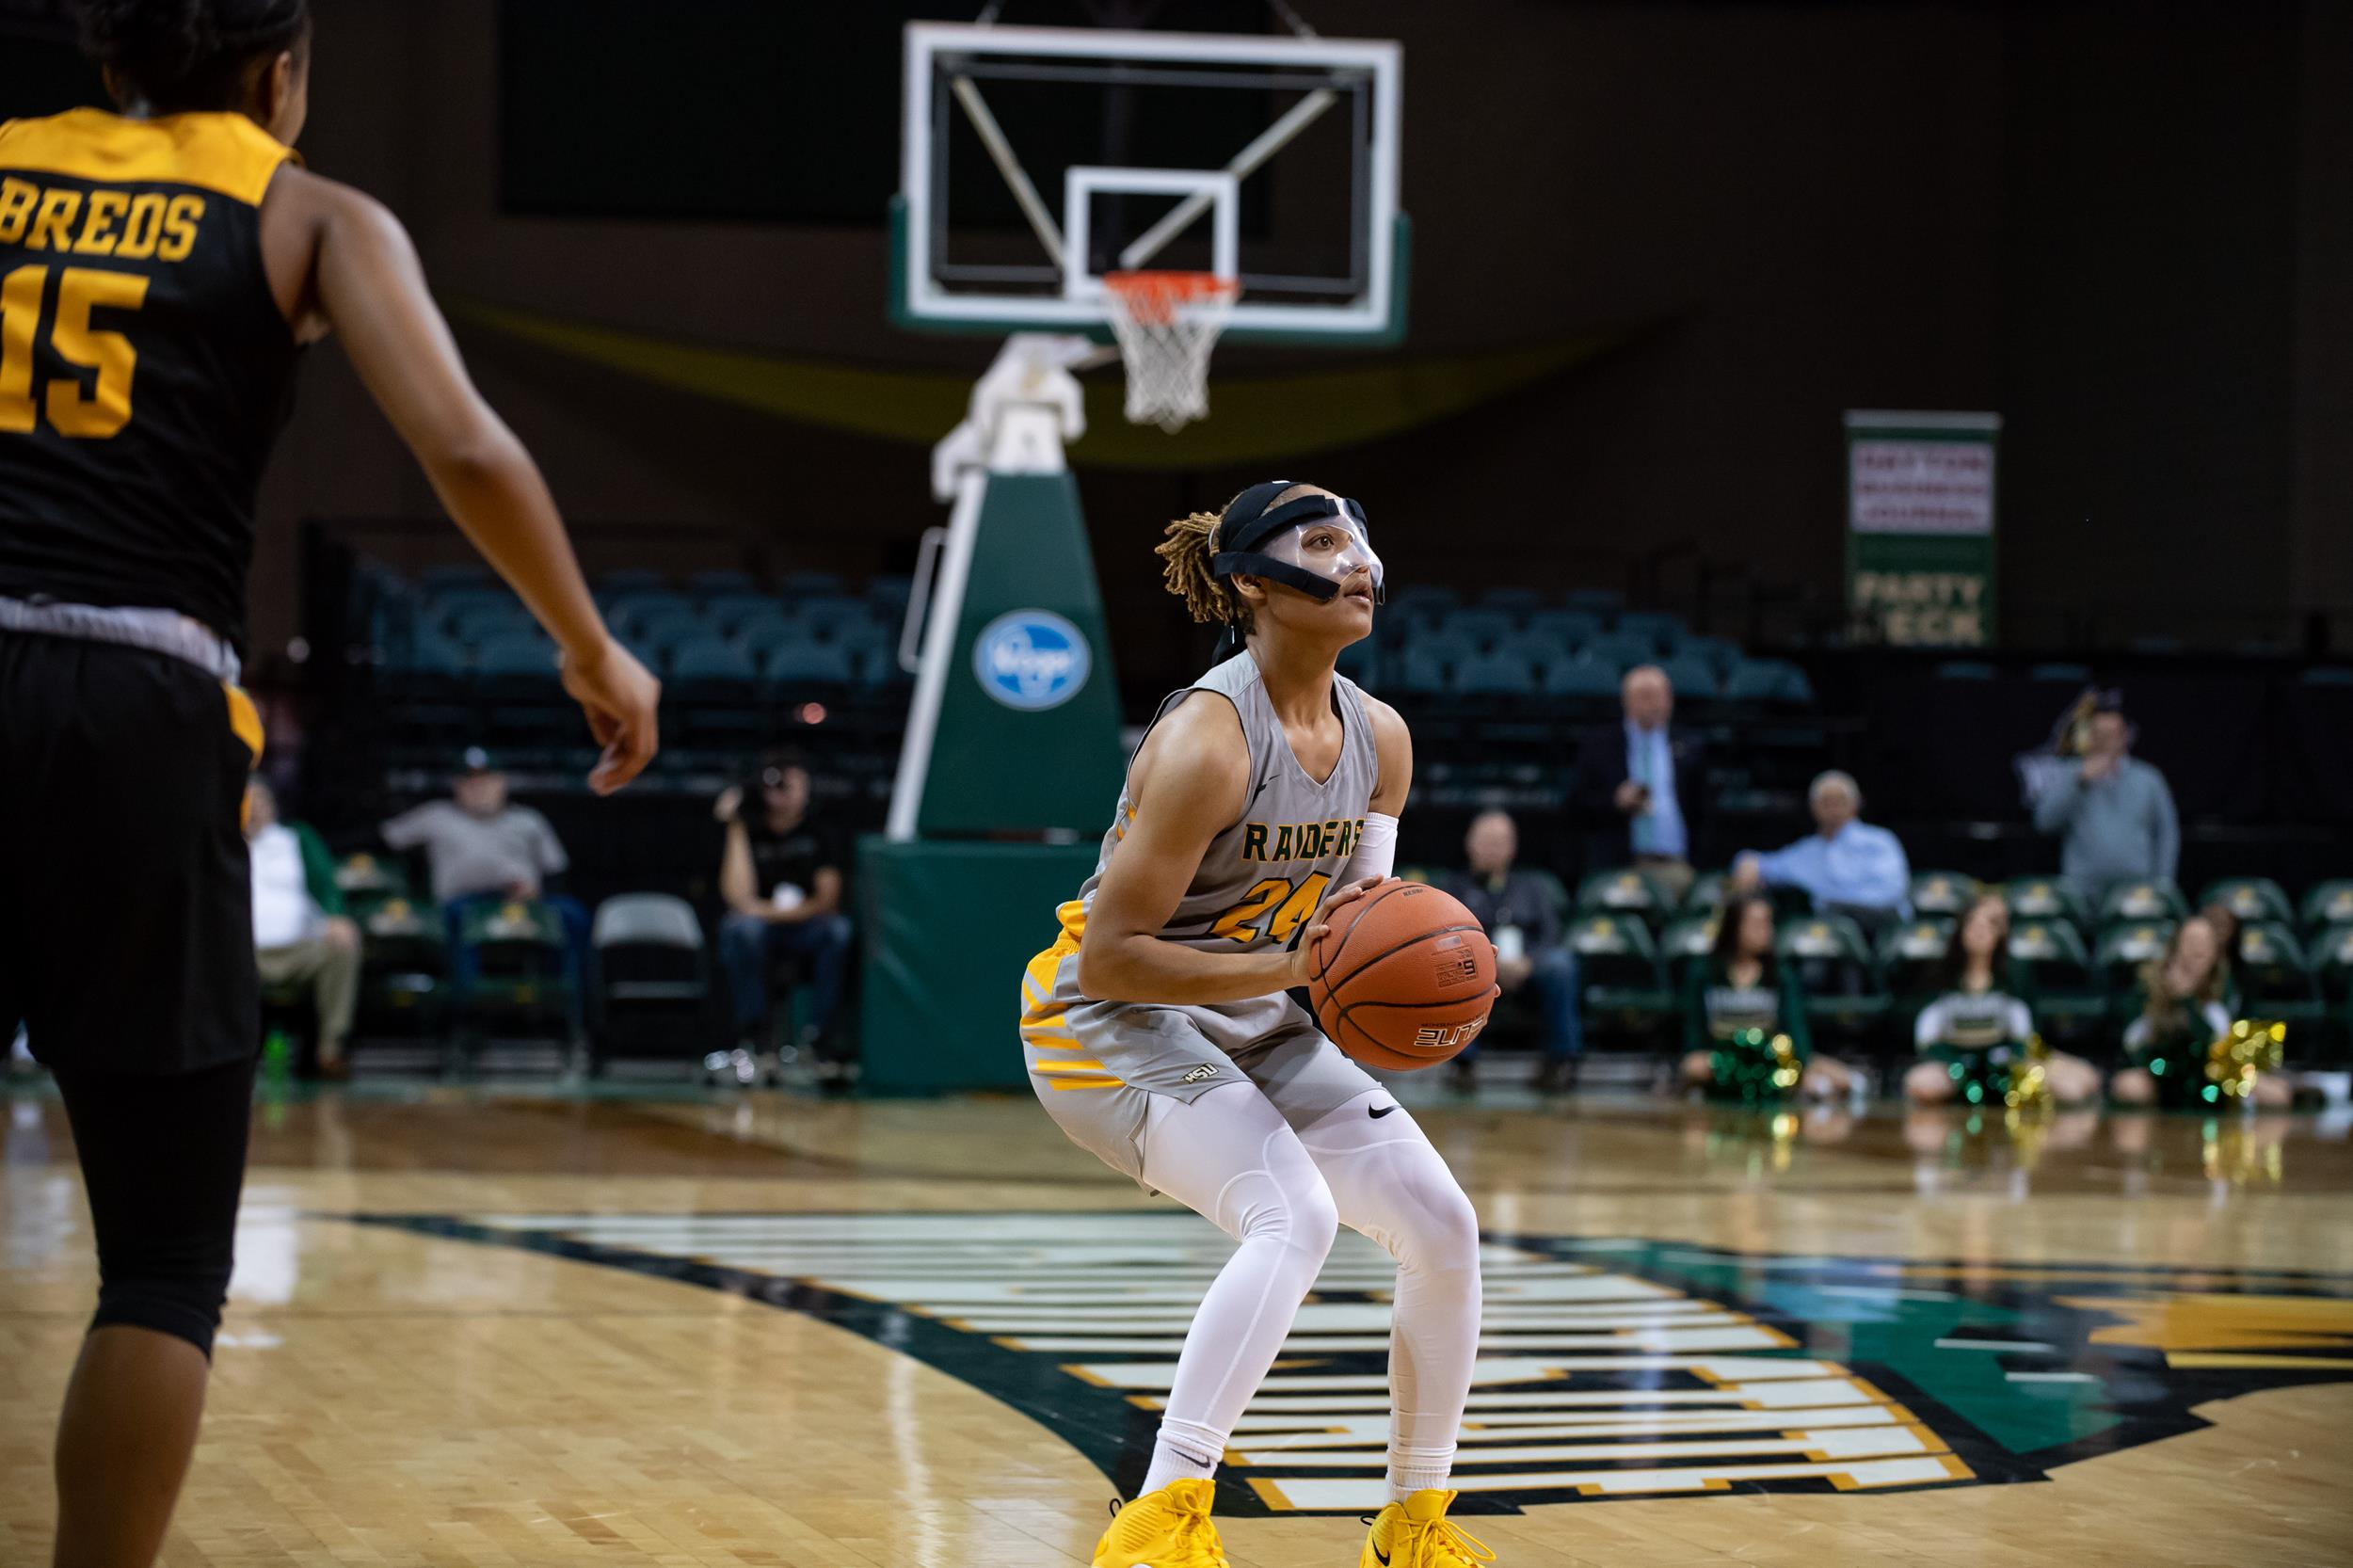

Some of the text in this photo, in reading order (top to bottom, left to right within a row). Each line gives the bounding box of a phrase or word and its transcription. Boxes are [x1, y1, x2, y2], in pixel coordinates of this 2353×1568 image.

[0, 176, 205, 262] BREDS
[0, 264, 150, 440] 15
[1849, 610, 1983, 648] ECK
[1241, 817, 1365, 862] RAIDERS
[1205, 870, 1332, 952] 24
